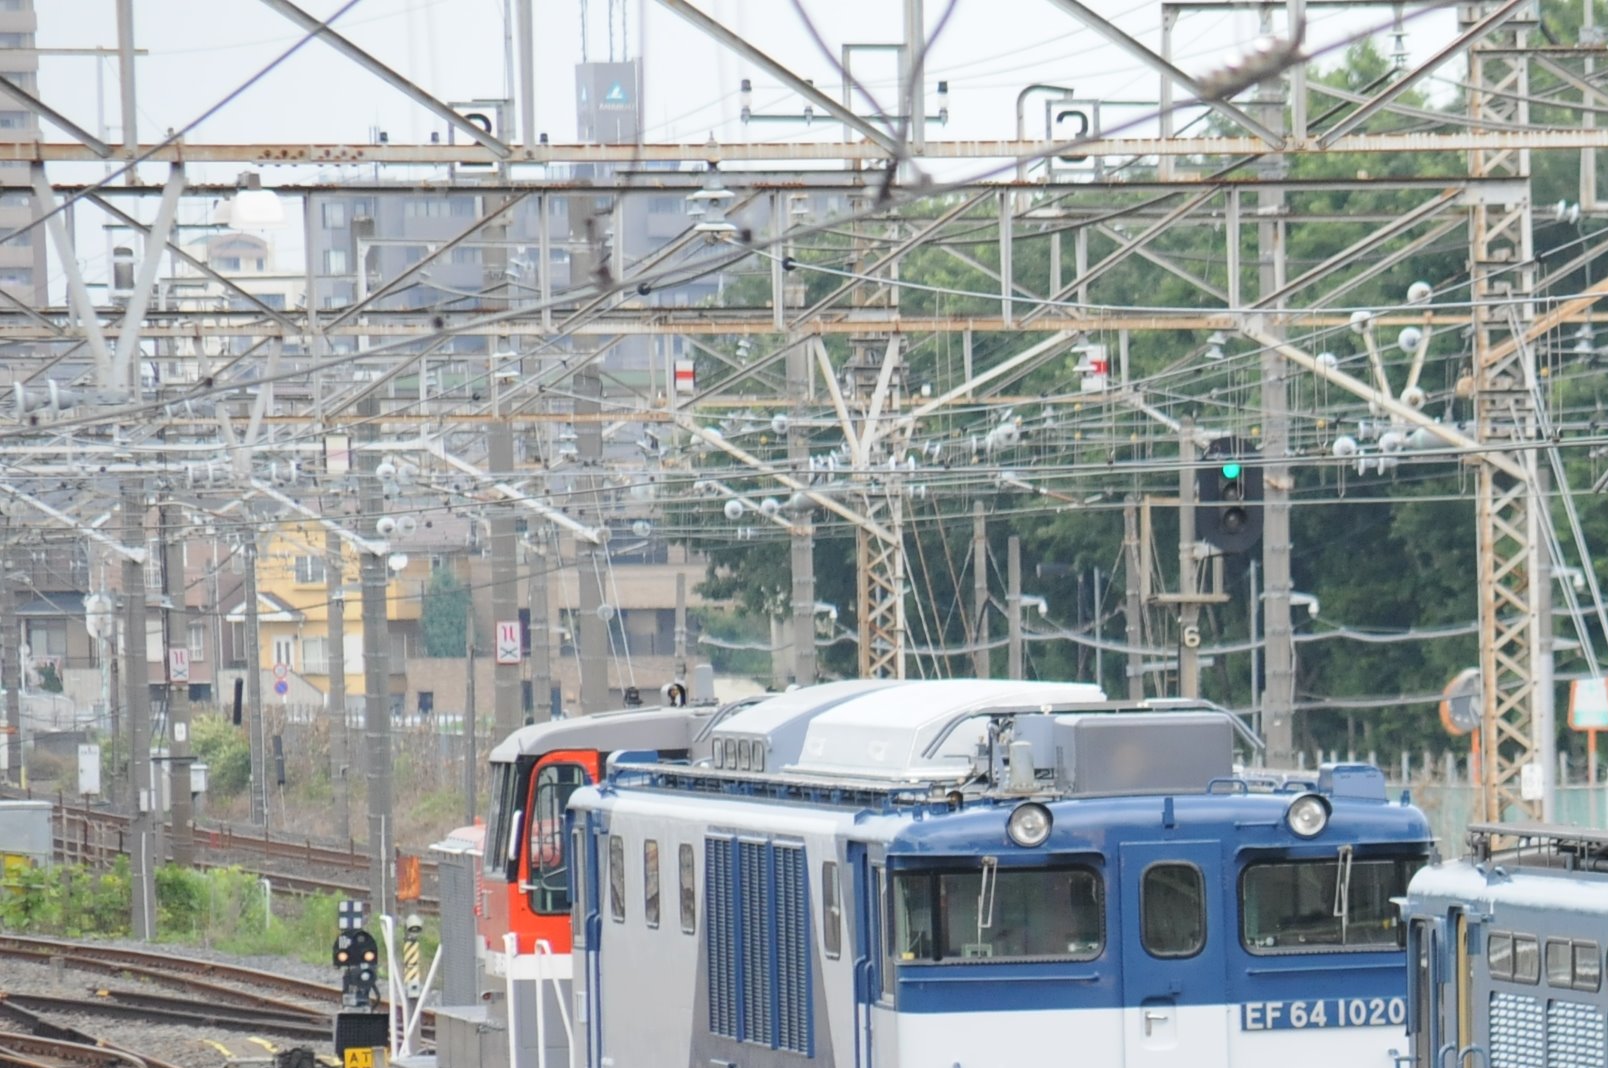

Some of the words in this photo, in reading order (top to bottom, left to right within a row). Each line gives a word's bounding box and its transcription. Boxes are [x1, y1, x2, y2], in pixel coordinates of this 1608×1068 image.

[1184, 626, 1200, 648] 6
[1246, 1001, 1284, 1030] EF
[1290, 999, 1327, 1029] 64
[1338, 997, 1406, 1027] 1020
